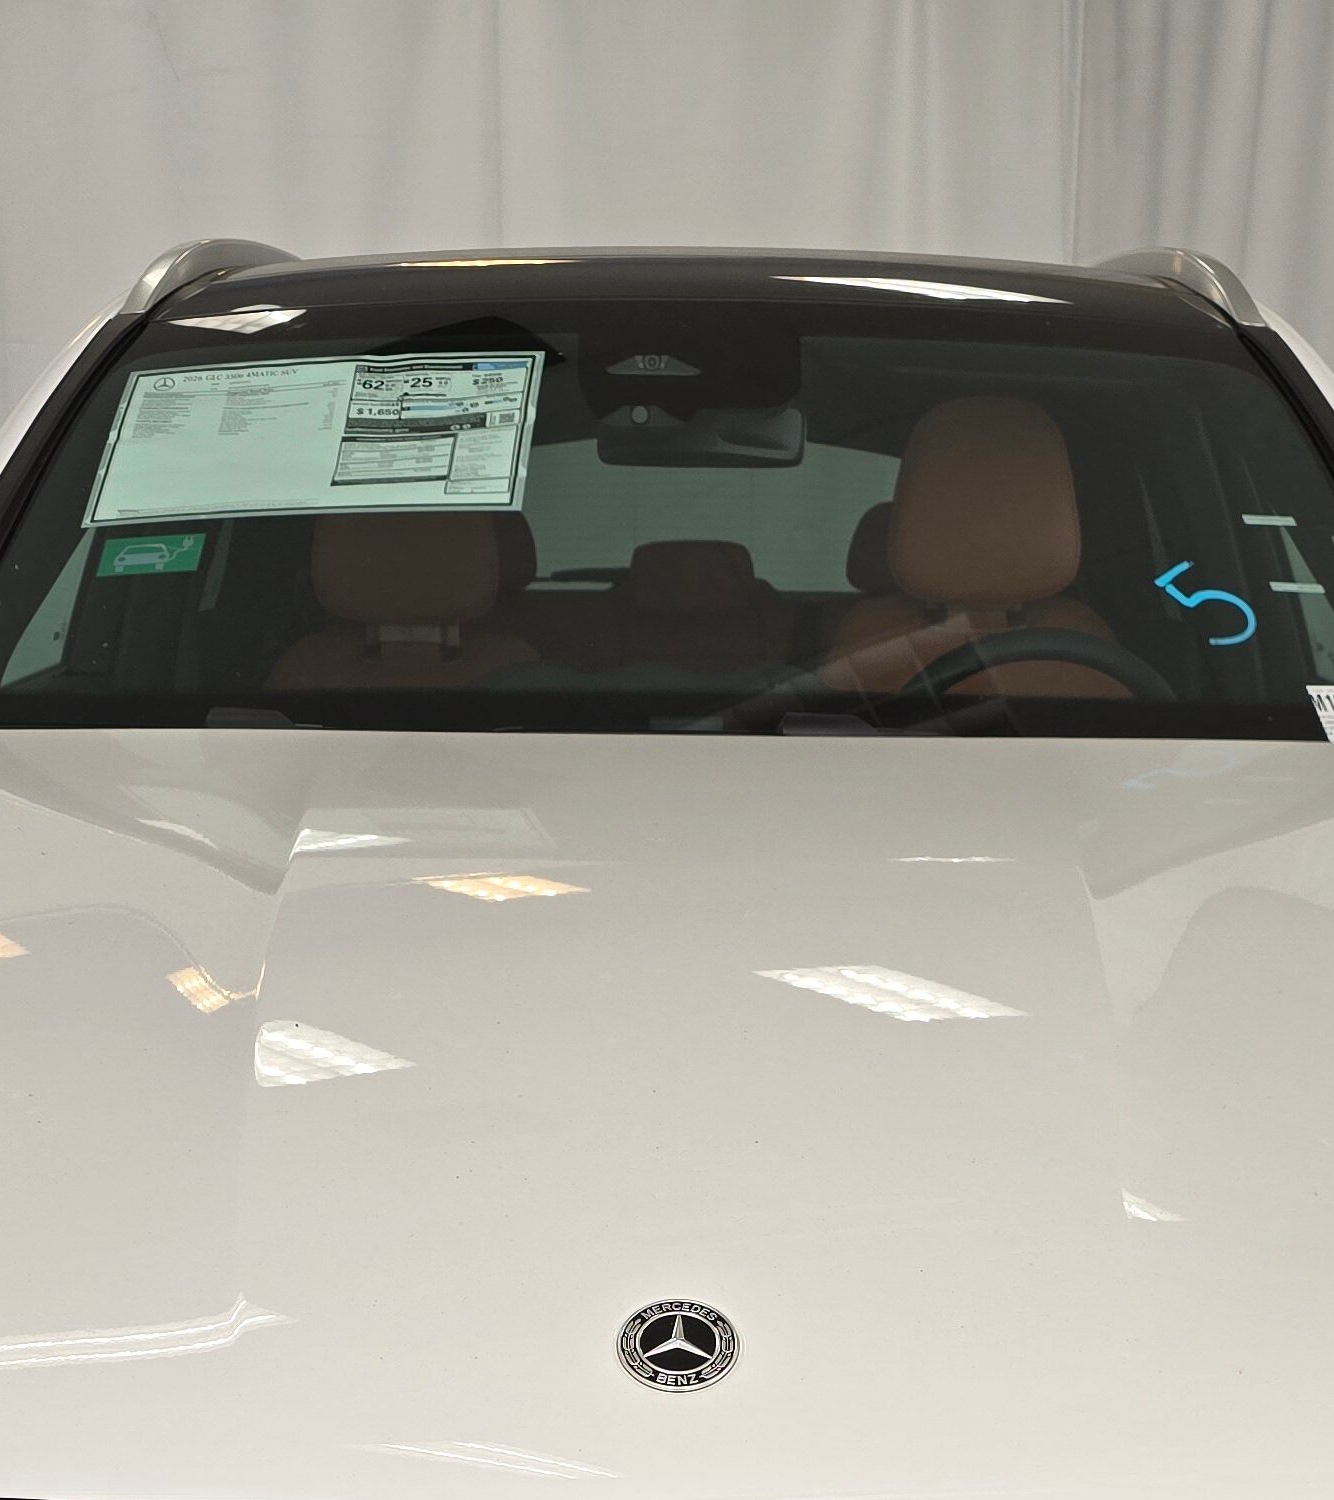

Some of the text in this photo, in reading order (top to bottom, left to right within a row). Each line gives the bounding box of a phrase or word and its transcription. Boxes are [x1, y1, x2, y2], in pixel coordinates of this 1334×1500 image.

[362, 379, 385, 391] 62
[410, 377, 433, 388] 25
[1154, 560, 1257, 646] 5
[642, 1303, 718, 1321] MERCEDES
[656, 1373, 699, 1386] BENZ
